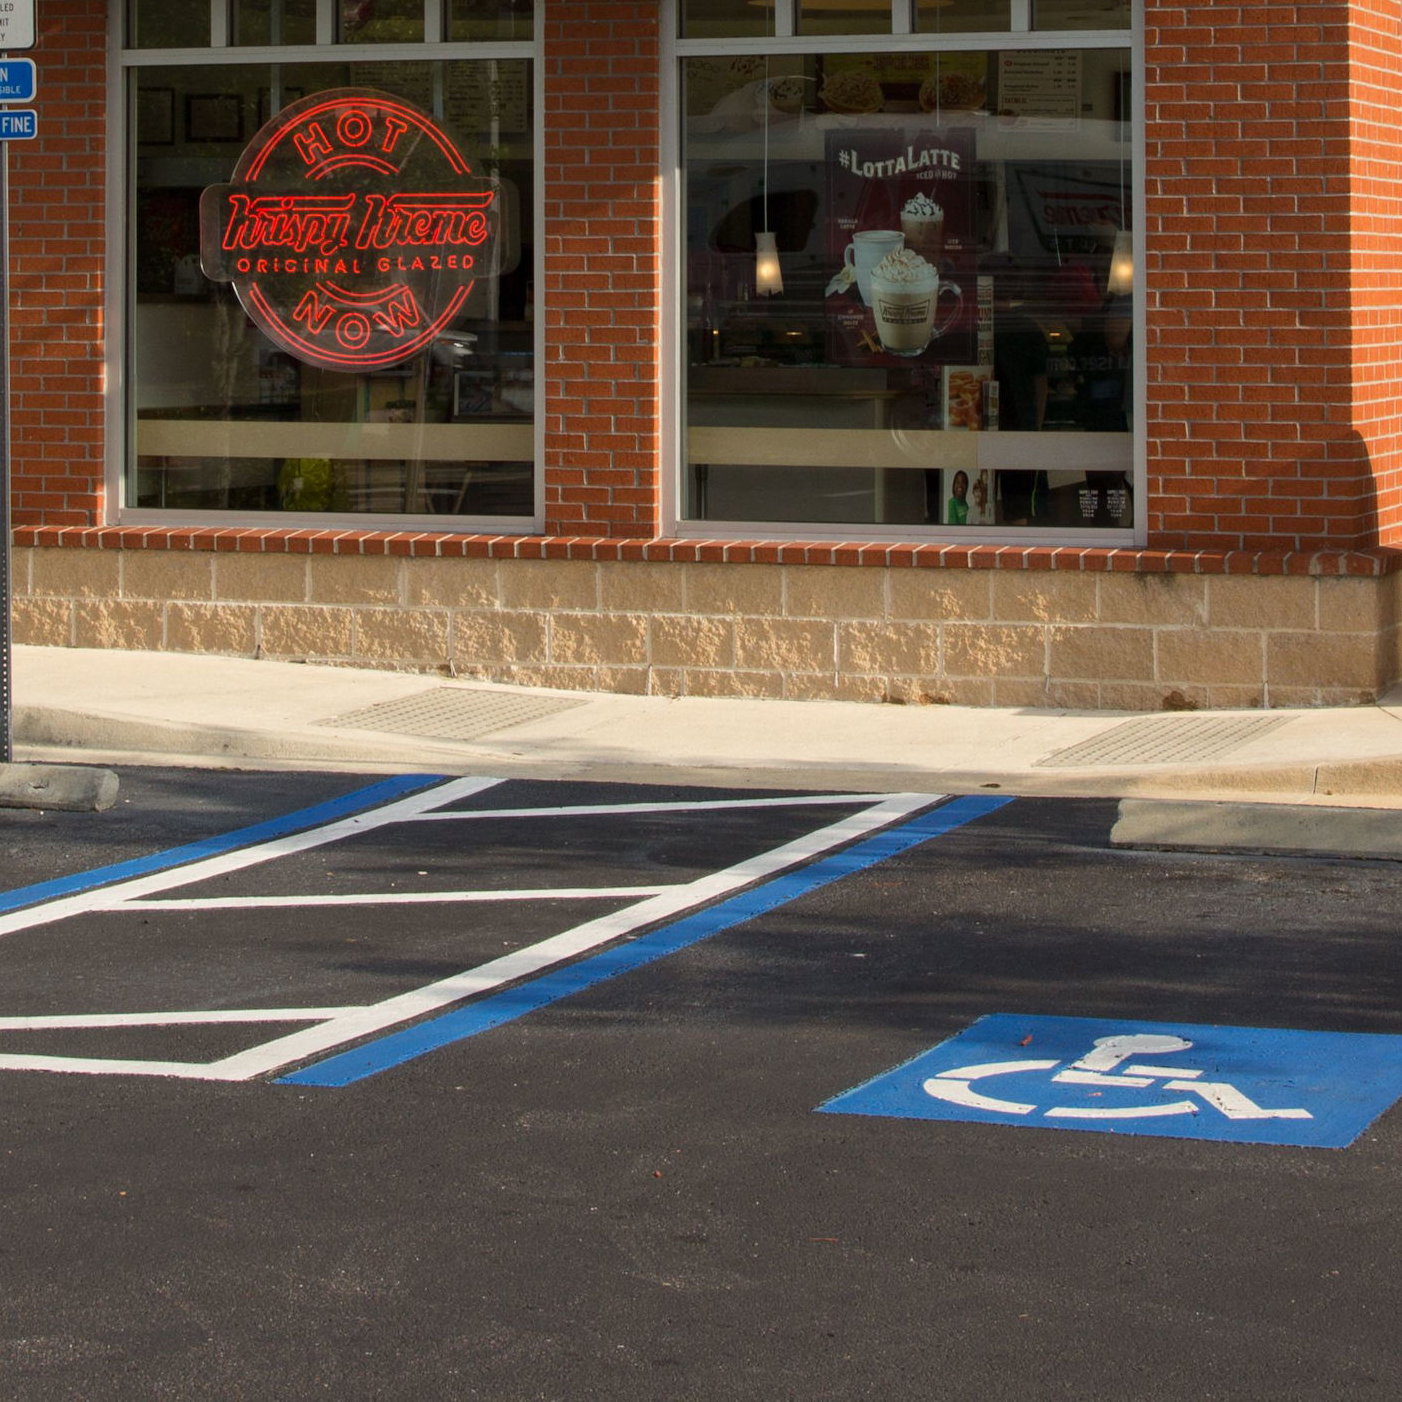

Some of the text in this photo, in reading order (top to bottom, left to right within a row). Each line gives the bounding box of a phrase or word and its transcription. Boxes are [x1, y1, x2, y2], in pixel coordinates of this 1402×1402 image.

[2, 116, 32, 134] FINE
[293, 109, 408, 165] HOT
[222, 190, 494, 256] Krispy Kreme
[237, 254, 475, 274] ORIGINAL GLAZED
[292, 285, 420, 350] NOW
